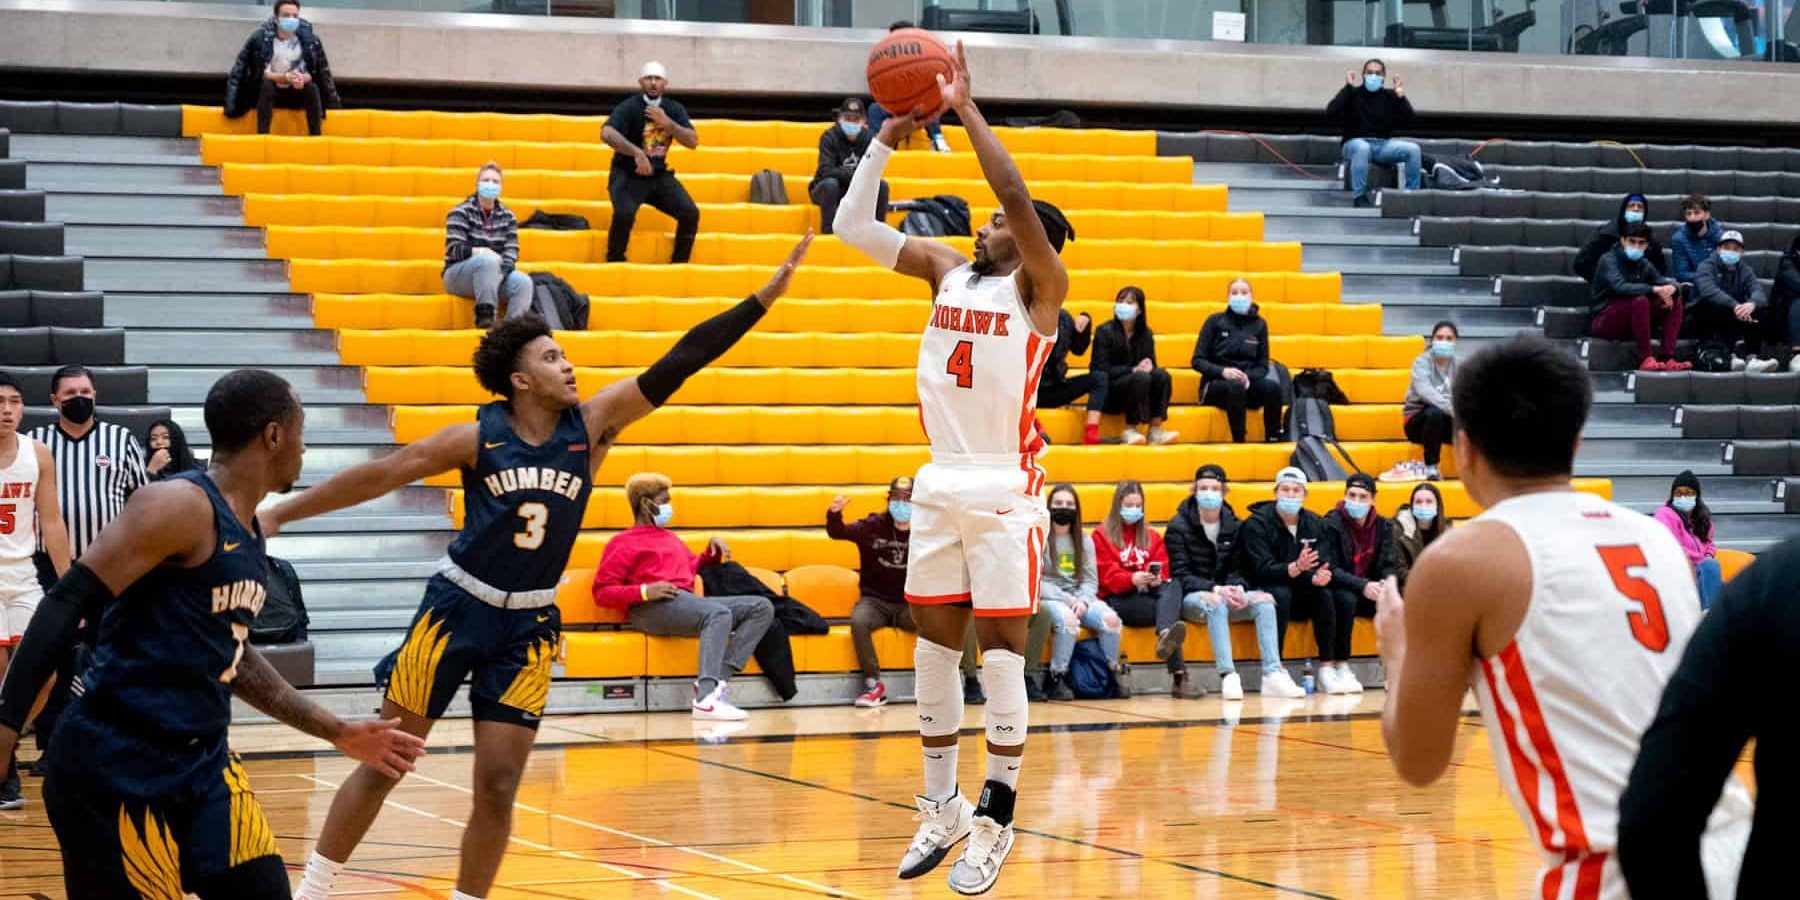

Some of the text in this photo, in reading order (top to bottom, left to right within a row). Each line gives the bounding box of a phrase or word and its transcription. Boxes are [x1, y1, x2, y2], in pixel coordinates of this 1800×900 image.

[930, 304, 1011, 337] MOHAWK
[946, 340, 974, 389] 4
[484, 466, 584, 502] HUMBER
[513, 501, 550, 551] 3
[1594, 543, 1671, 654] 5
